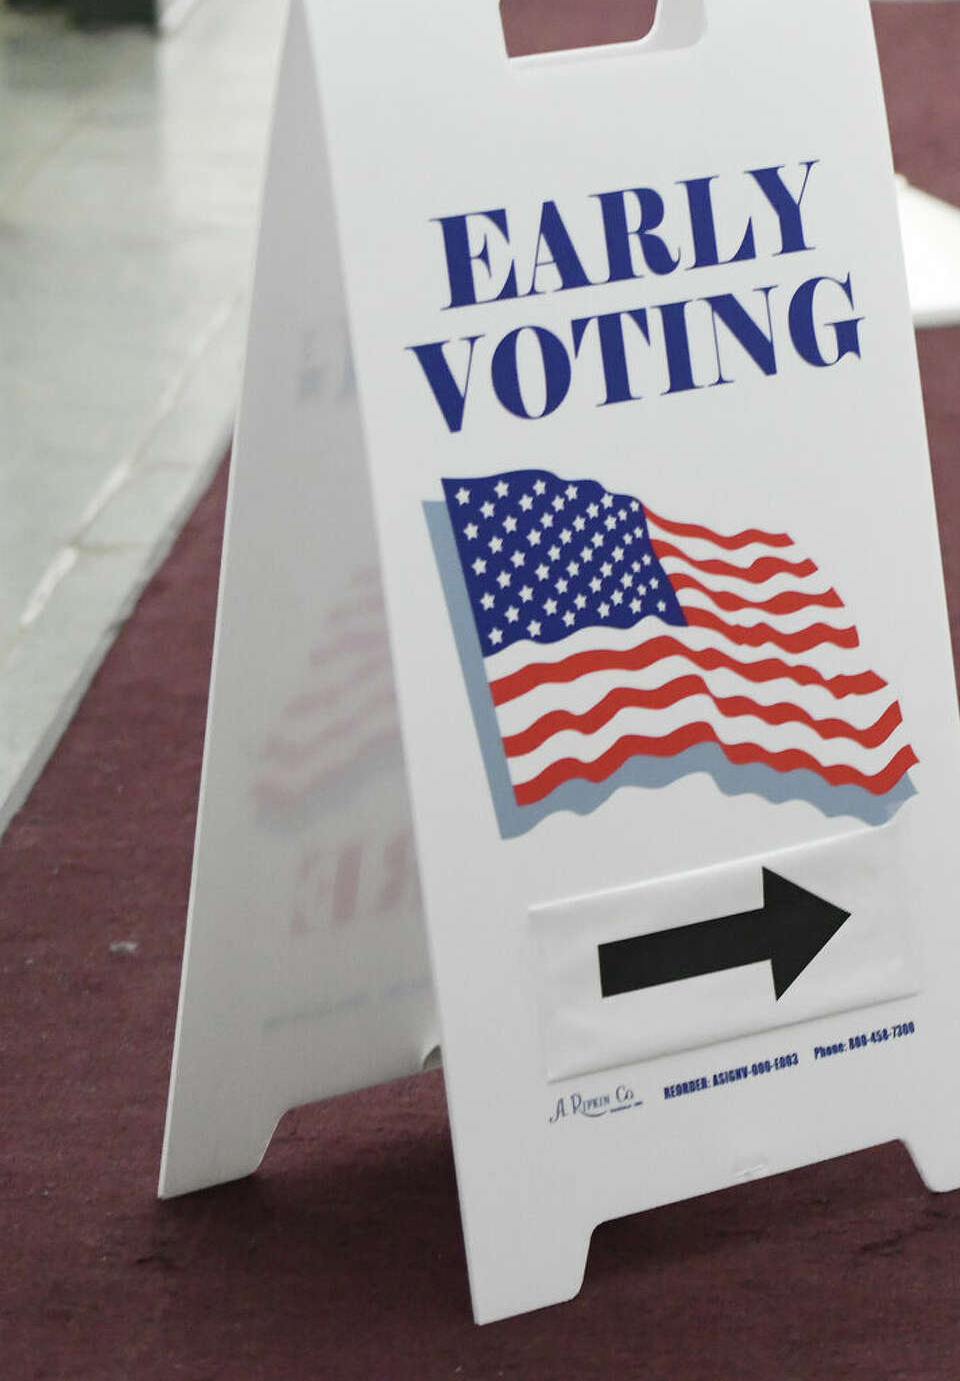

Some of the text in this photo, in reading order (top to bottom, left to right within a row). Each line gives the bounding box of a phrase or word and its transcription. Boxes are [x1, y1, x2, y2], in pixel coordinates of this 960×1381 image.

[429, 159, 820, 310] EARLY
[405, 272, 866, 433] VOTING
[663, 1076, 712, 1100] REORDER:
[814, 1042, 847, 1060] Phone:
